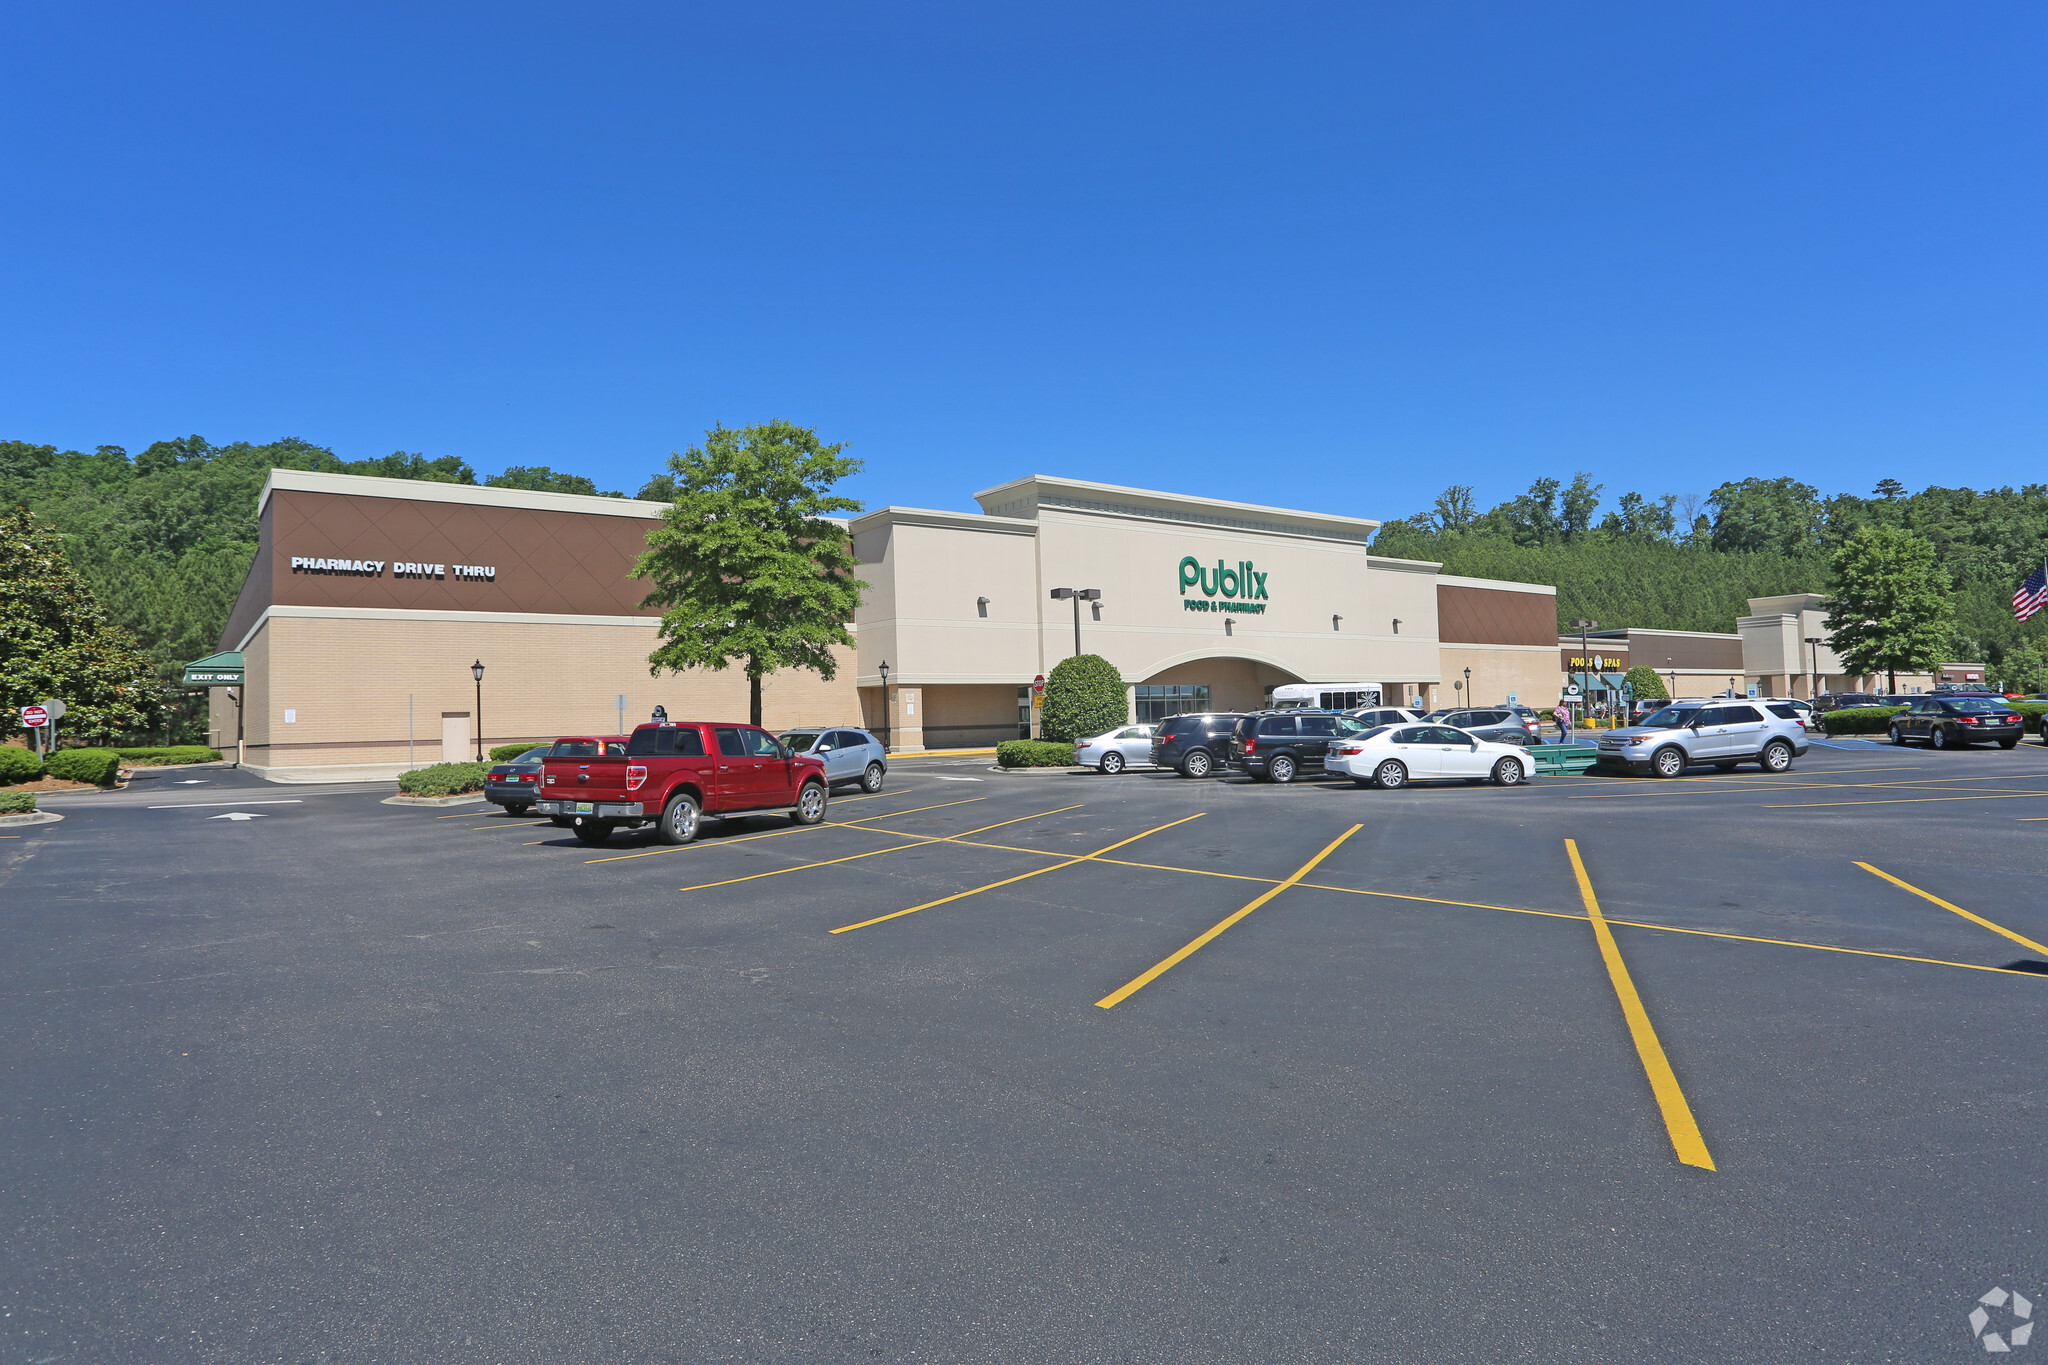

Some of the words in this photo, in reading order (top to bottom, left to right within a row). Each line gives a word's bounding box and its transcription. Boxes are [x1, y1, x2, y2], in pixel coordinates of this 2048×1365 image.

[291, 556, 385, 573] PHARMACY
[393, 561, 445, 576] DRIVE
[452, 564, 496, 578] THRU
[1179, 556, 1268, 598] Publix
[1184, 599, 1209, 611] FOOD
[1211, 600, 1217, 611] &
[1219, 601, 1266, 613] PHARMACY
[1570, 657, 1593, 667] POOS
[1603, 658, 1621, 668] SPAS
